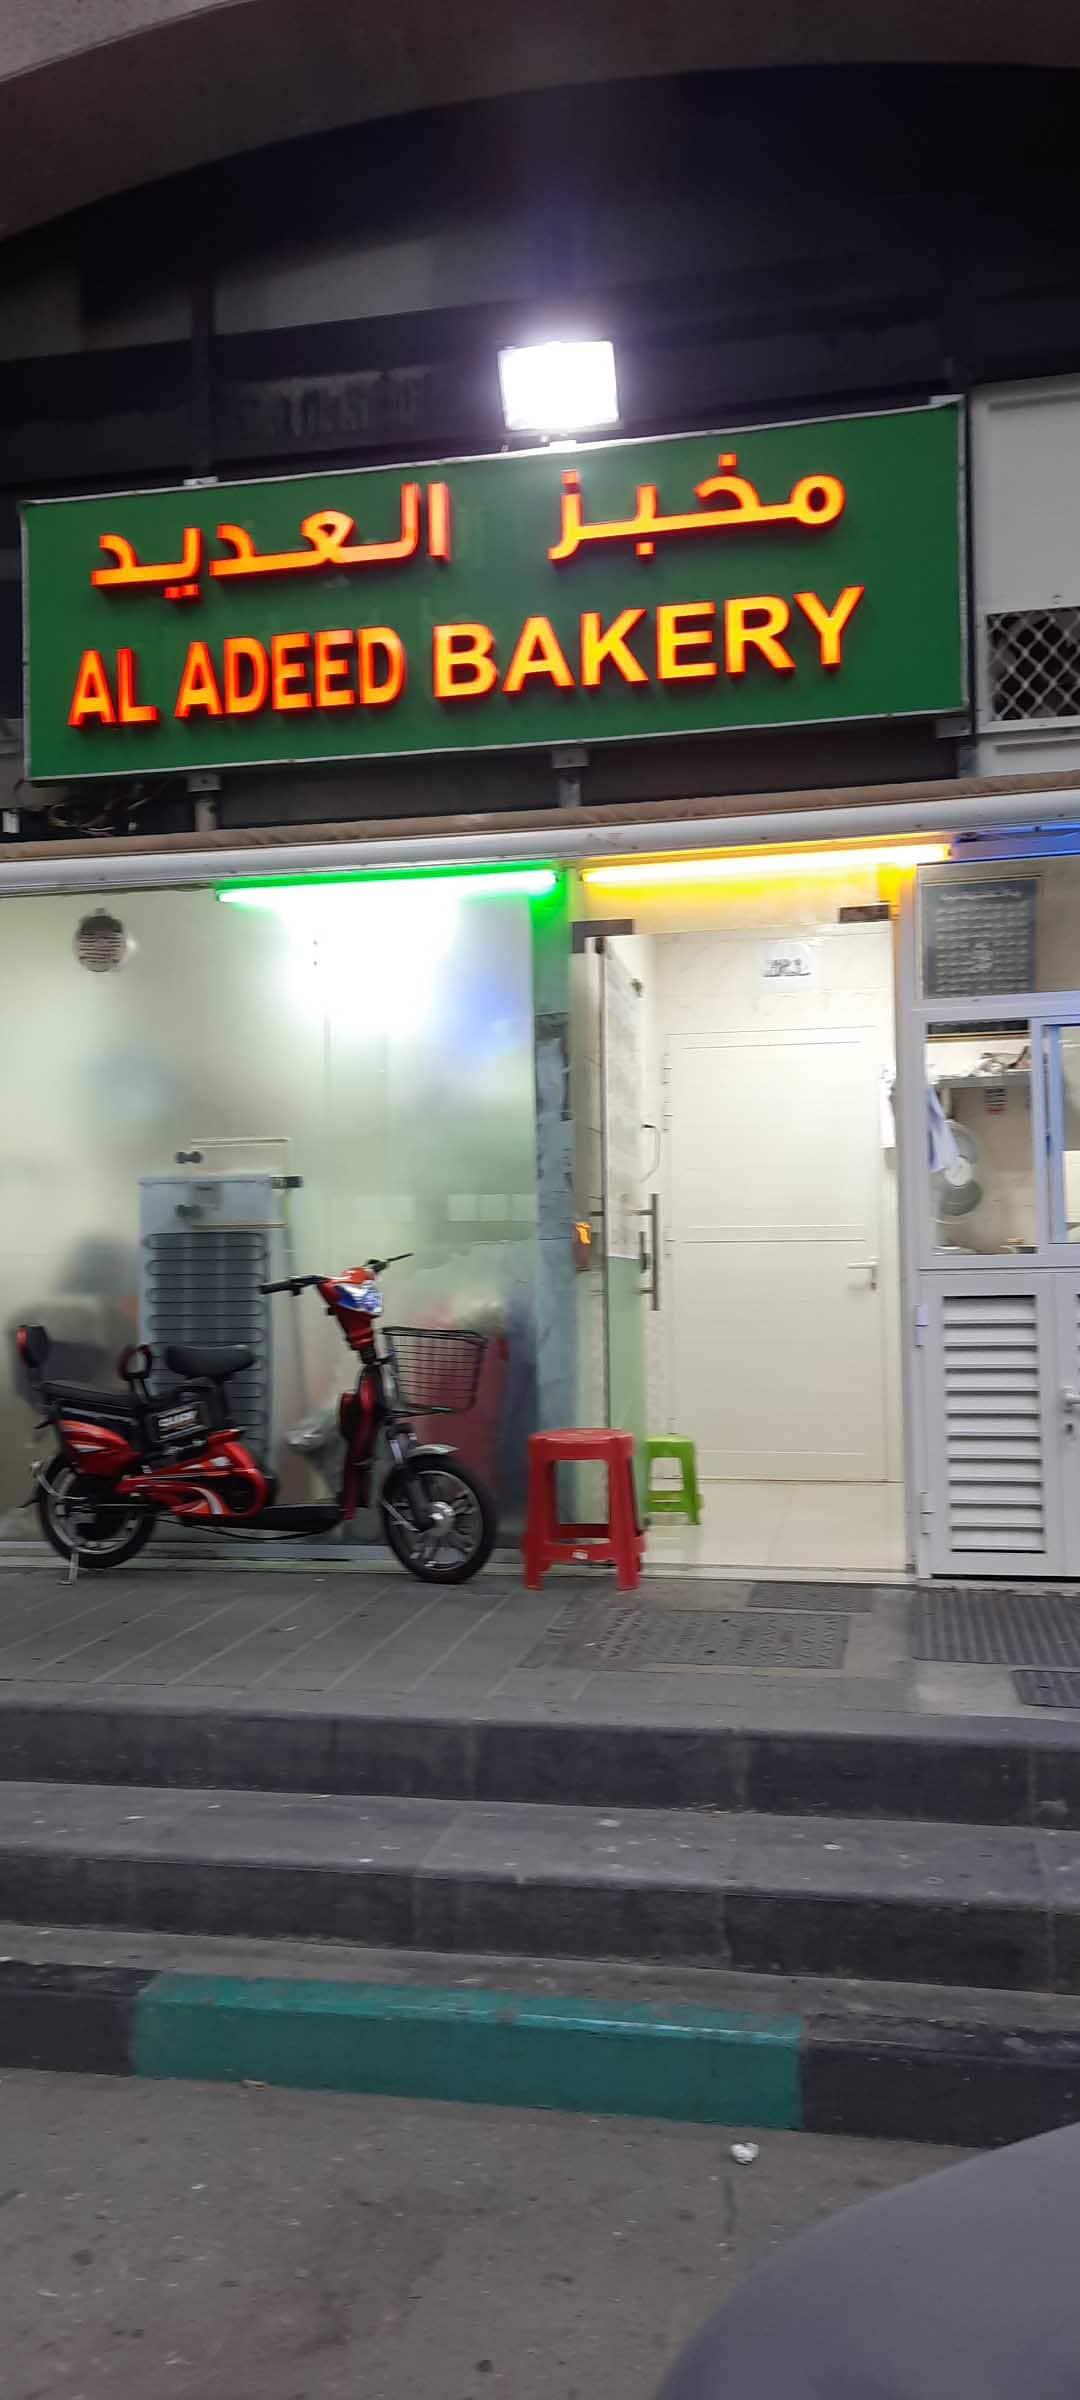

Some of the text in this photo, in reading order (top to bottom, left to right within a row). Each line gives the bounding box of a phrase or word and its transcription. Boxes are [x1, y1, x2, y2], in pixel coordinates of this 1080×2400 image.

[91, 453, 847, 600] مخبز العديد
[67, 585, 866, 728] AL ADEED BAKERY
